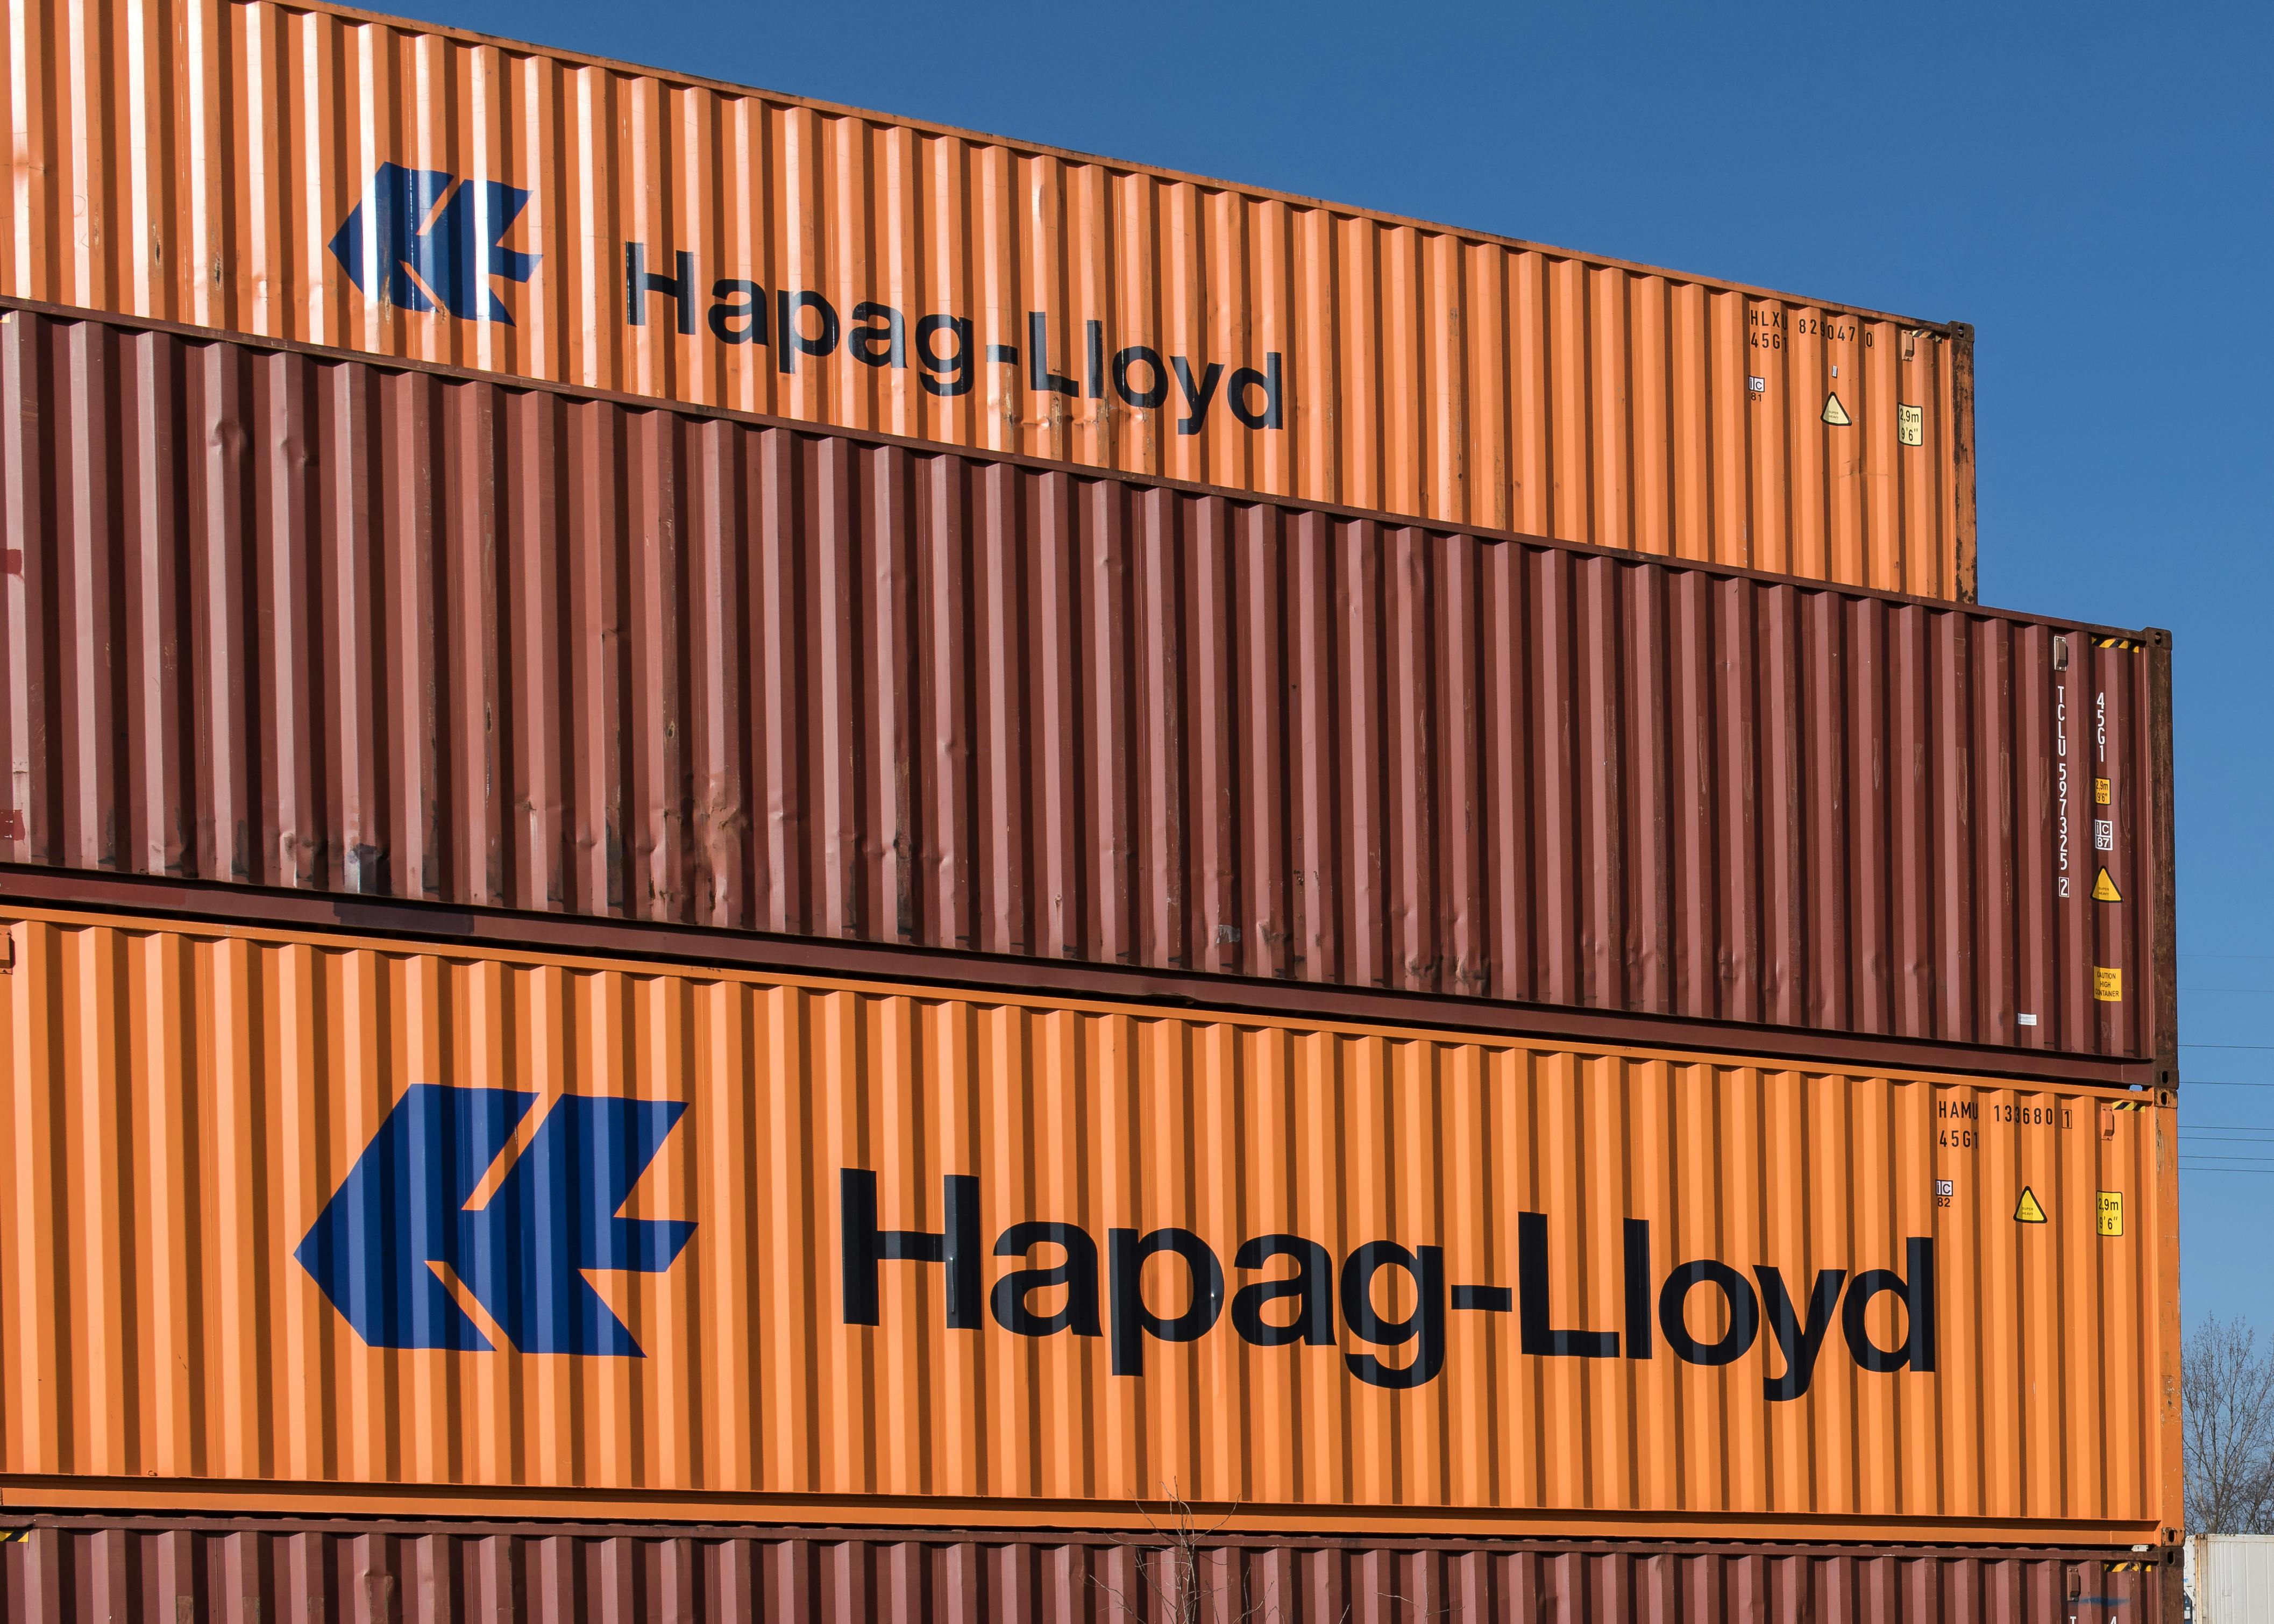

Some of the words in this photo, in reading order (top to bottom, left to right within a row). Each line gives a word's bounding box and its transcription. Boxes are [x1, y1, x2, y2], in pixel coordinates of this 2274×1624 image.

[626, 240, 1284, 436] Hapag-Lloyd
[1750, 309, 1788, 330] HLXU
[1799, 318, 1856, 342] 829047
[1866, 332, 1873, 348] 0
[1750, 332, 1788, 353] 45G1
[1751, 391, 1761, 402] 81
[1900, 408, 1919, 424] 2,9m
[2057, 686, 2066, 757] TCLU
[2097, 692, 2105, 763] 45G1
[2059, 763, 2067, 870] 597325
[2097, 837, 2109, 847] 87
[2060, 878, 2067, 896] 2
[2097, 971, 2116, 979] CAUTION
[2095, 988, 2119, 997] CONTAINER
[1938, 1101, 1978, 1120] HAMU
[1994, 1105, 2053, 1125] 133680
[2064, 1111, 2070, 1128] 1
[1939, 1130, 1978, 1149] 45G1
[1937, 1197, 1951, 1207] 82
[2098, 1198, 2119, 1213] 2,9m
[840, 1167, 1937, 1401] Hapag-Lloyd
